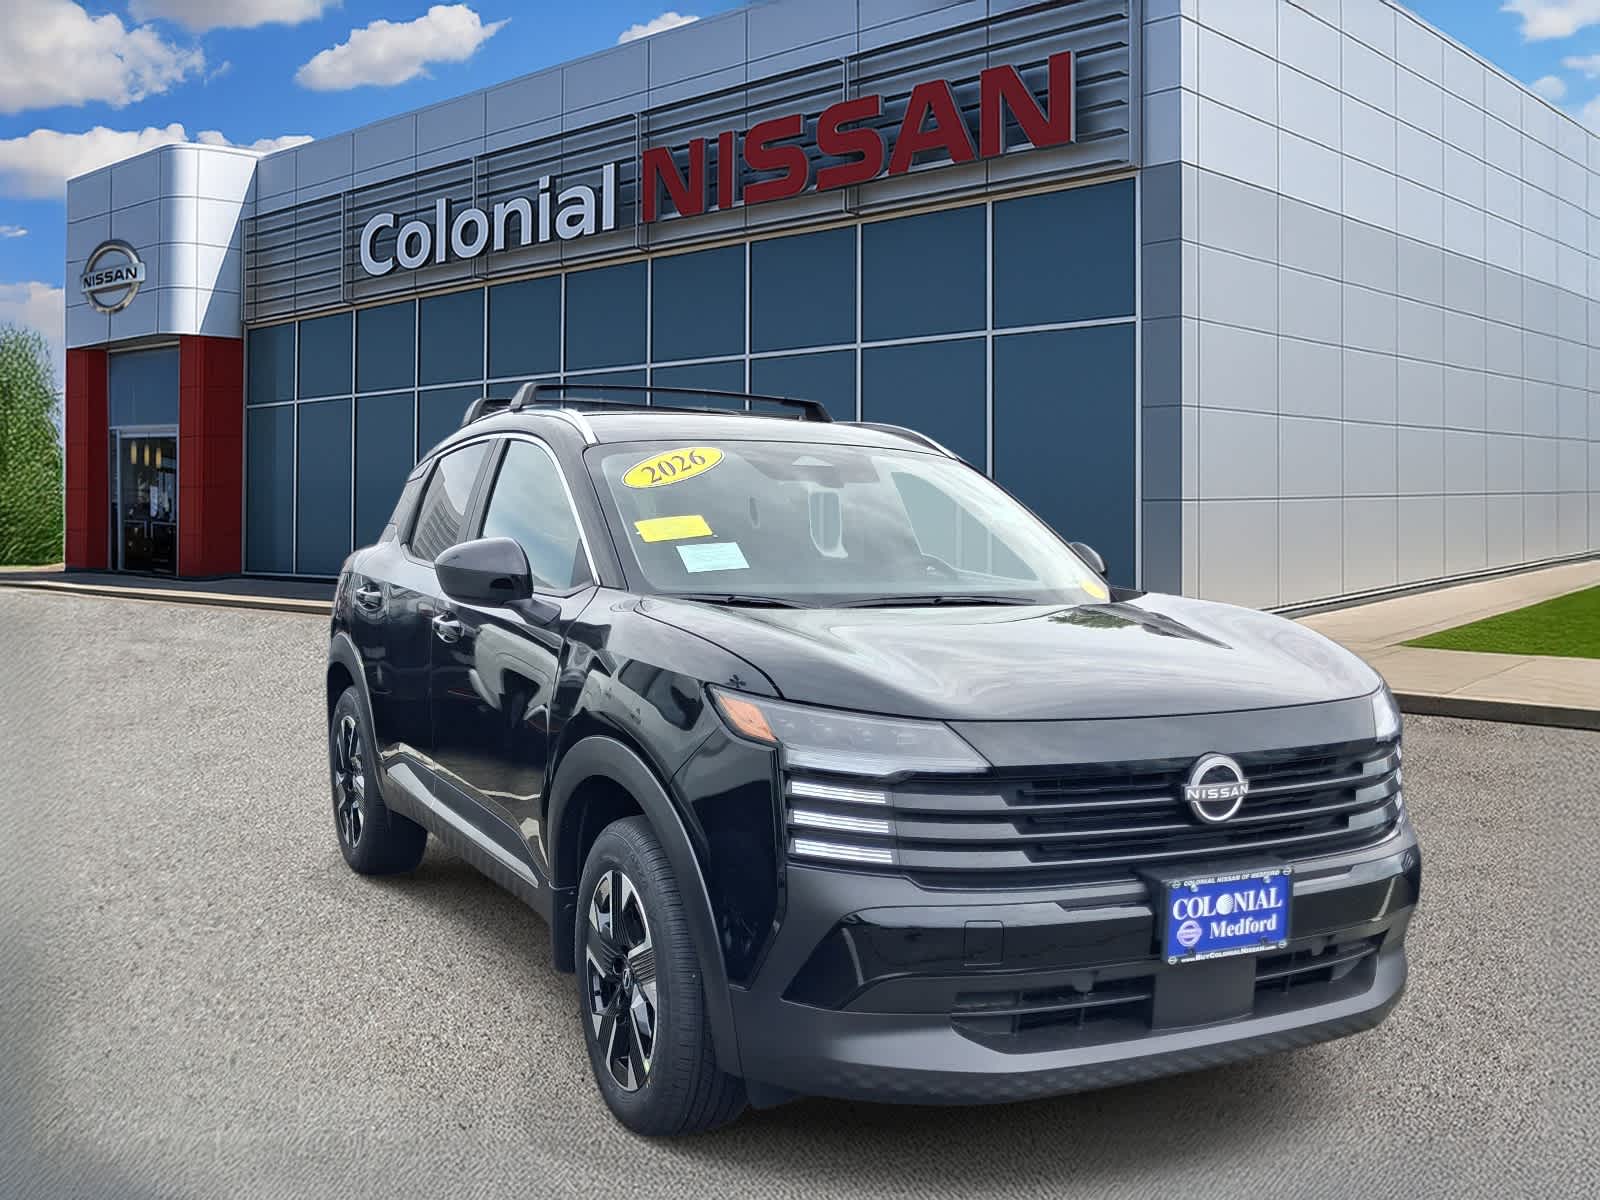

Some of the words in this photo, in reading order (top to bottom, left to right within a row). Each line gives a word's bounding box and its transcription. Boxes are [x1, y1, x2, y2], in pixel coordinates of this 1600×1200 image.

[360, 163, 617, 277] Colonial
[642, 50, 1077, 224] NISSAN
[83, 267, 138, 289] NISSAN
[641, 450, 706, 484] 2026
[1187, 783, 1249, 799] NISSAN
[1217, 875, 1241, 883] NISSAN
[1173, 887, 1282, 920] COLONIAL
[1209, 913, 1277, 939] Medford
